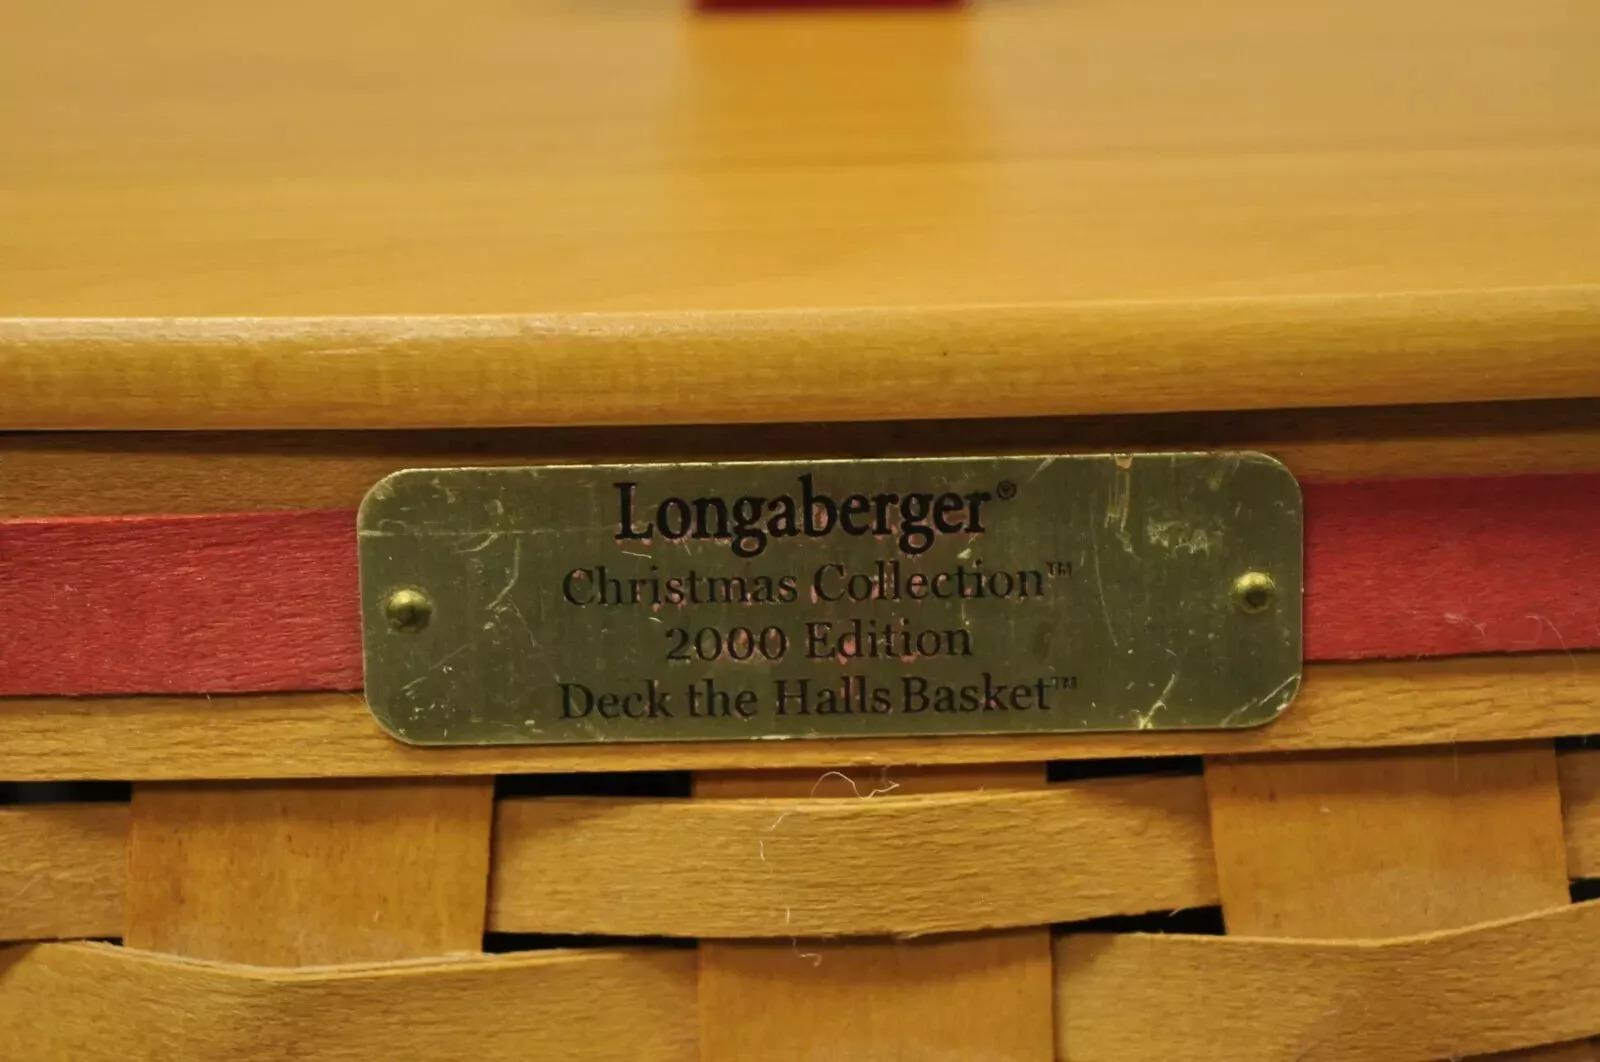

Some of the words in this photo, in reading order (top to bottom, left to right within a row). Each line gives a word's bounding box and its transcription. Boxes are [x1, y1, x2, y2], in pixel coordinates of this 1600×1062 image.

[563, 565, 798, 605] Christmas
[666, 626, 788, 661] 2000
[805, 619, 973, 659] Edition
[558, 679, 674, 719] Deck
[688, 678, 758, 717] the
[775, 675, 893, 716] Halls
